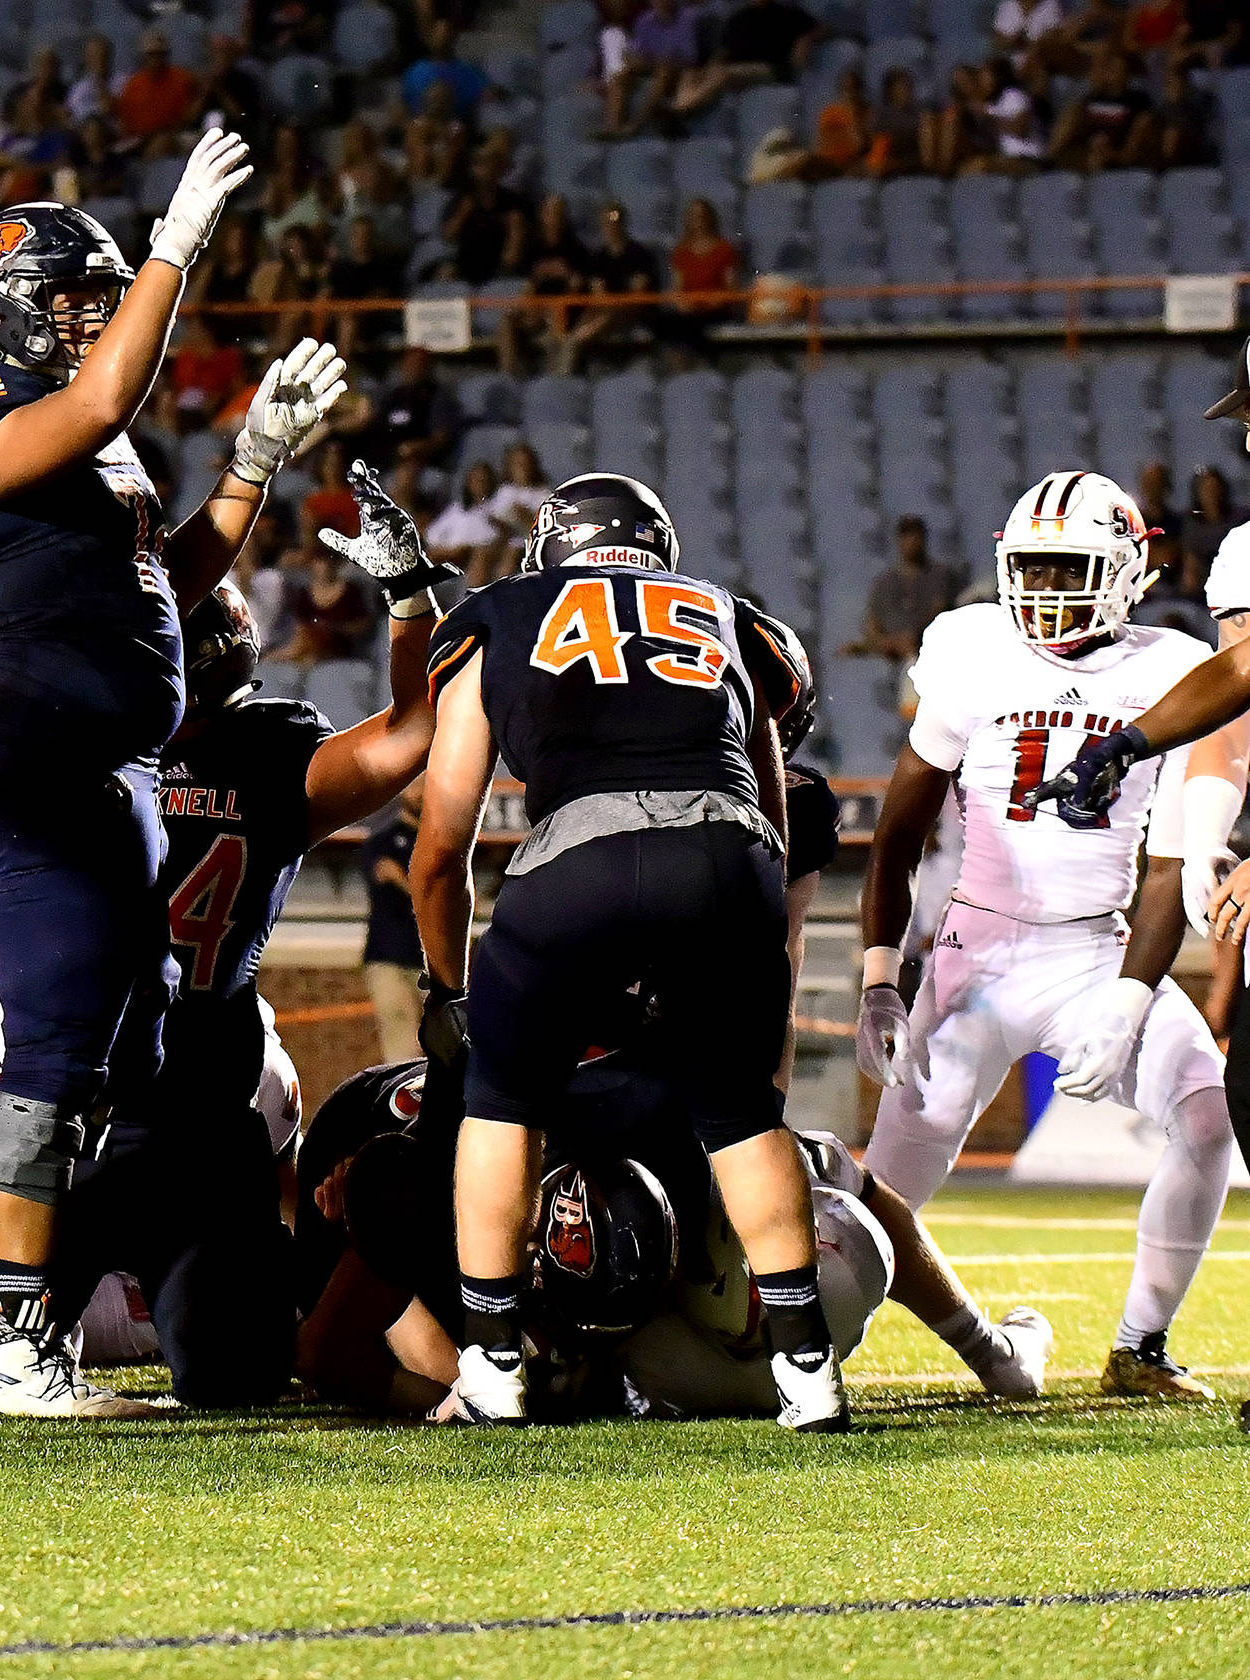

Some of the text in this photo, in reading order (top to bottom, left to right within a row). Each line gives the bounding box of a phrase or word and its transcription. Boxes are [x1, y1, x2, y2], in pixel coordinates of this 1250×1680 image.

[586, 548, 650, 569] Riddell
[529, 577, 732, 690] 45
[157, 786, 242, 821] KNELL
